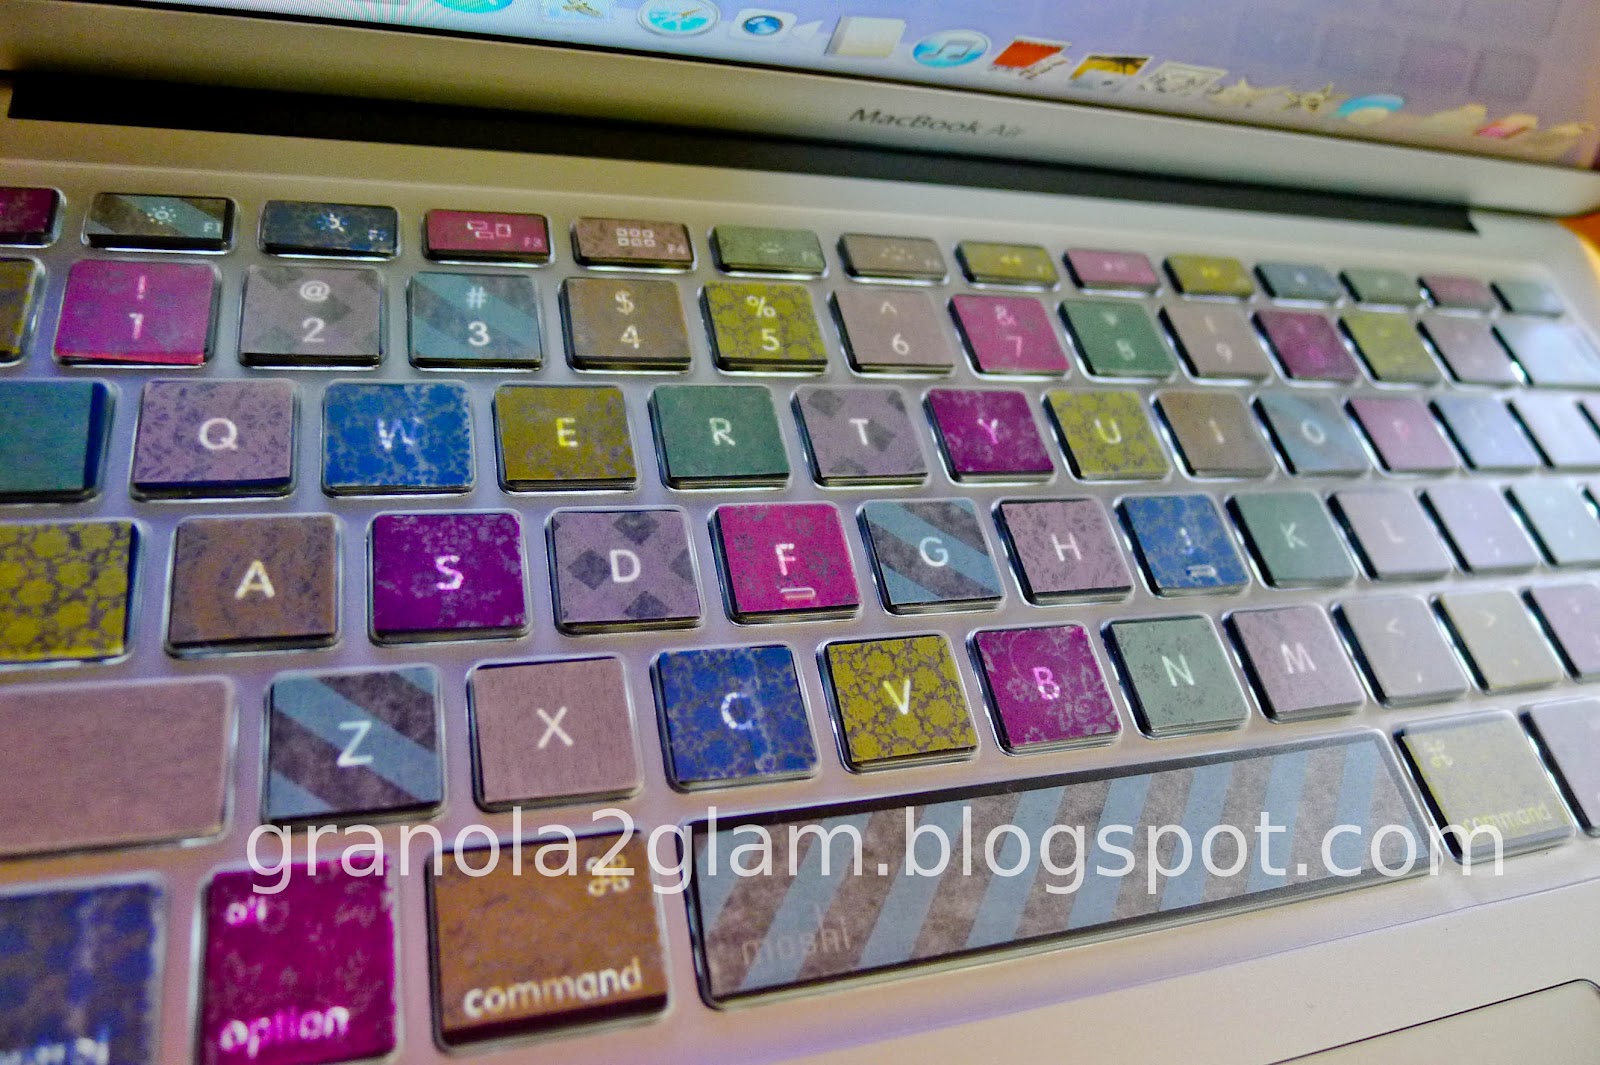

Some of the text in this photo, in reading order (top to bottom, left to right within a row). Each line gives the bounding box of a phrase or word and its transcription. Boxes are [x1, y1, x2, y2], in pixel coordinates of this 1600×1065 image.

[849, 107, 979, 135] MacBook
[137, 275, 146, 300] !
[300, 281, 331, 302] @
[466, 286, 487, 310] #
[614, 290, 635, 316] $
[746, 295, 776, 319] %
[128, 312, 145, 340] 1
[301, 317, 327, 344] 2
[468, 321, 490, 346] 3
[620, 325, 643, 349] 4
[761, 328, 780, 352] 5
[892, 333, 910, 355] 6
[1005, 334, 1023, 359] 7
[199, 417, 239, 452] Q
[376, 416, 425, 450] W
[556, 417, 579, 448] E
[709, 417, 736, 446] R
[849, 417, 869, 446] T
[977, 418, 998, 444] Y
[1094, 418, 1122, 444] U
[1300, 418, 1326, 445] O
[1051, 532, 1083, 562] H
[1280, 521, 1307, 550] K
[609, 548, 642, 584] D
[775, 542, 797, 576] F
[919, 536, 950, 567] G
[234, 559, 275, 599] A
[435, 554, 465, 591] S
[1161, 653, 1196, 688] N
[1278, 641, 1317, 675] M
[883, 678, 911, 716] V
[1033, 665, 1062, 700] B
[721, 691, 755, 730] C
[536, 705, 574, 749] X
[336, 719, 374, 768] Z
[463, 957, 644, 1019] command
[219, 1006, 351, 1060] option
